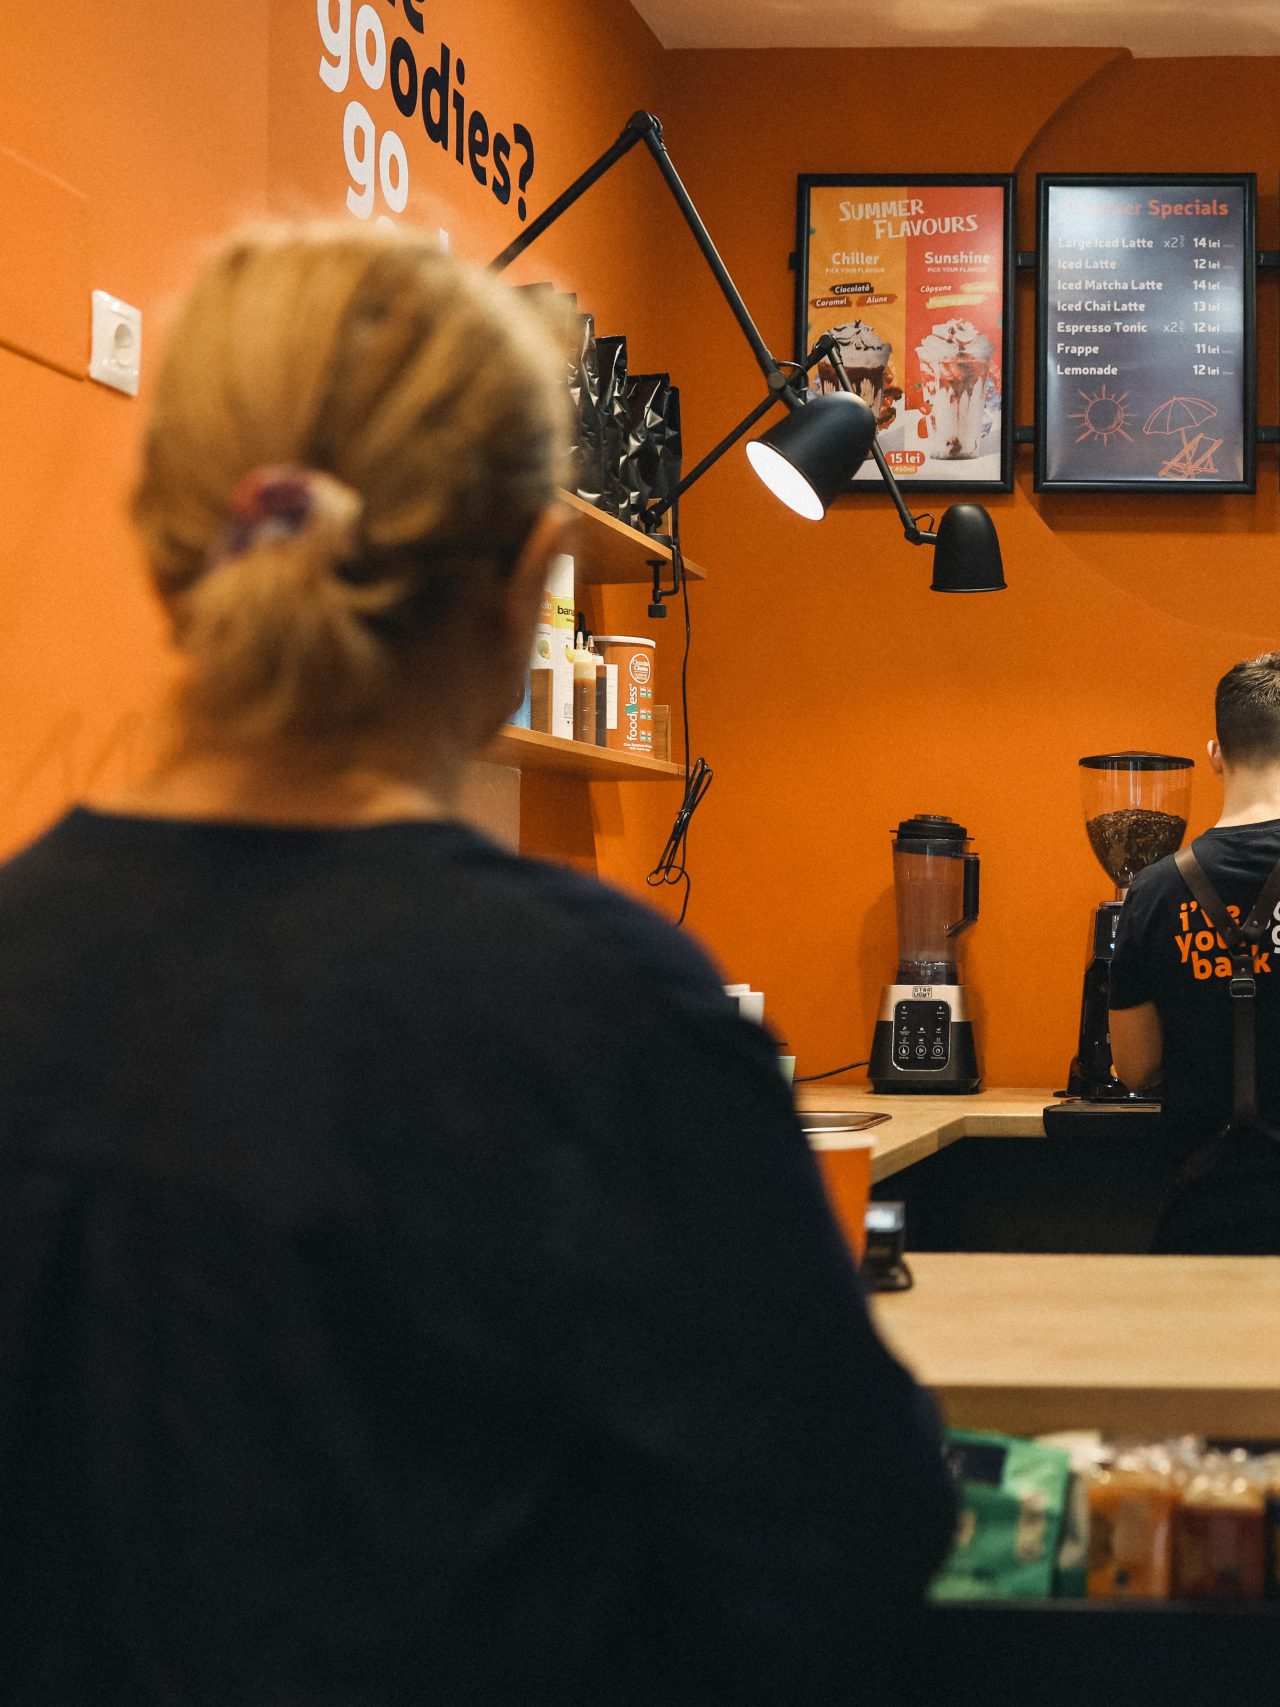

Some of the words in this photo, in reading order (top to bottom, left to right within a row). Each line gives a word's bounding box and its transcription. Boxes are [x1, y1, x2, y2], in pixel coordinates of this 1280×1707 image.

[343, 100, 409, 220] go
[839, 199, 924, 222] SUMMER
[1148, 199, 1229, 220] Specials
[873, 214, 978, 240] FLAVOURS
[1057, 238, 1094, 250] Large
[1095, 237, 1120, 248] Iced
[1122, 238, 1154, 248] Latte
[1163, 237, 1178, 249] x2
[1193, 238, 1207, 248] 14
[1208, 239, 1221, 248] lei
[831, 252, 880, 265] Chiller
[924, 251, 992, 264] Sunshine
[1057, 259, 1082, 269] Iced
[1085, 259, 1117, 269] Latte
[1193, 259, 1207, 269] 12
[1208, 260, 1221, 269] lei
[1057, 280, 1082, 290] Iced
[1084, 280, 1129, 290] Matcha
[1131, 280, 1163, 290] Latte
[1193, 280, 1207, 290] 14
[1208, 281, 1221, 290] lei
[816, 297, 847, 307] Caramel
[866, 296, 888, 304] Alune
[1057, 301, 1082, 312] Iced
[1084, 301, 1111, 312] Chai
[1114, 301, 1145, 312] Latte
[1193, 301, 1206, 312] 13
[1208, 302, 1221, 312] lei
[1057, 322, 1111, 335] Espresso
[1114, 322, 1147, 333] Tonic
[1163, 322, 1177, 333] x2
[1193, 322, 1206, 333] 12
[1208, 324, 1220, 333] lei
[1057, 343, 1099, 356] Frappe
[1195, 343, 1206, 354] 11
[1208, 345, 1220, 354] lei
[1057, 365, 1118, 375] Lemonade
[1193, 365, 1206, 375] 12
[1208, 366, 1220, 375] lei
[890, 453, 903, 464] 15
[905, 453, 920, 464] lei
[1191, 944, 1272, 980] bak
